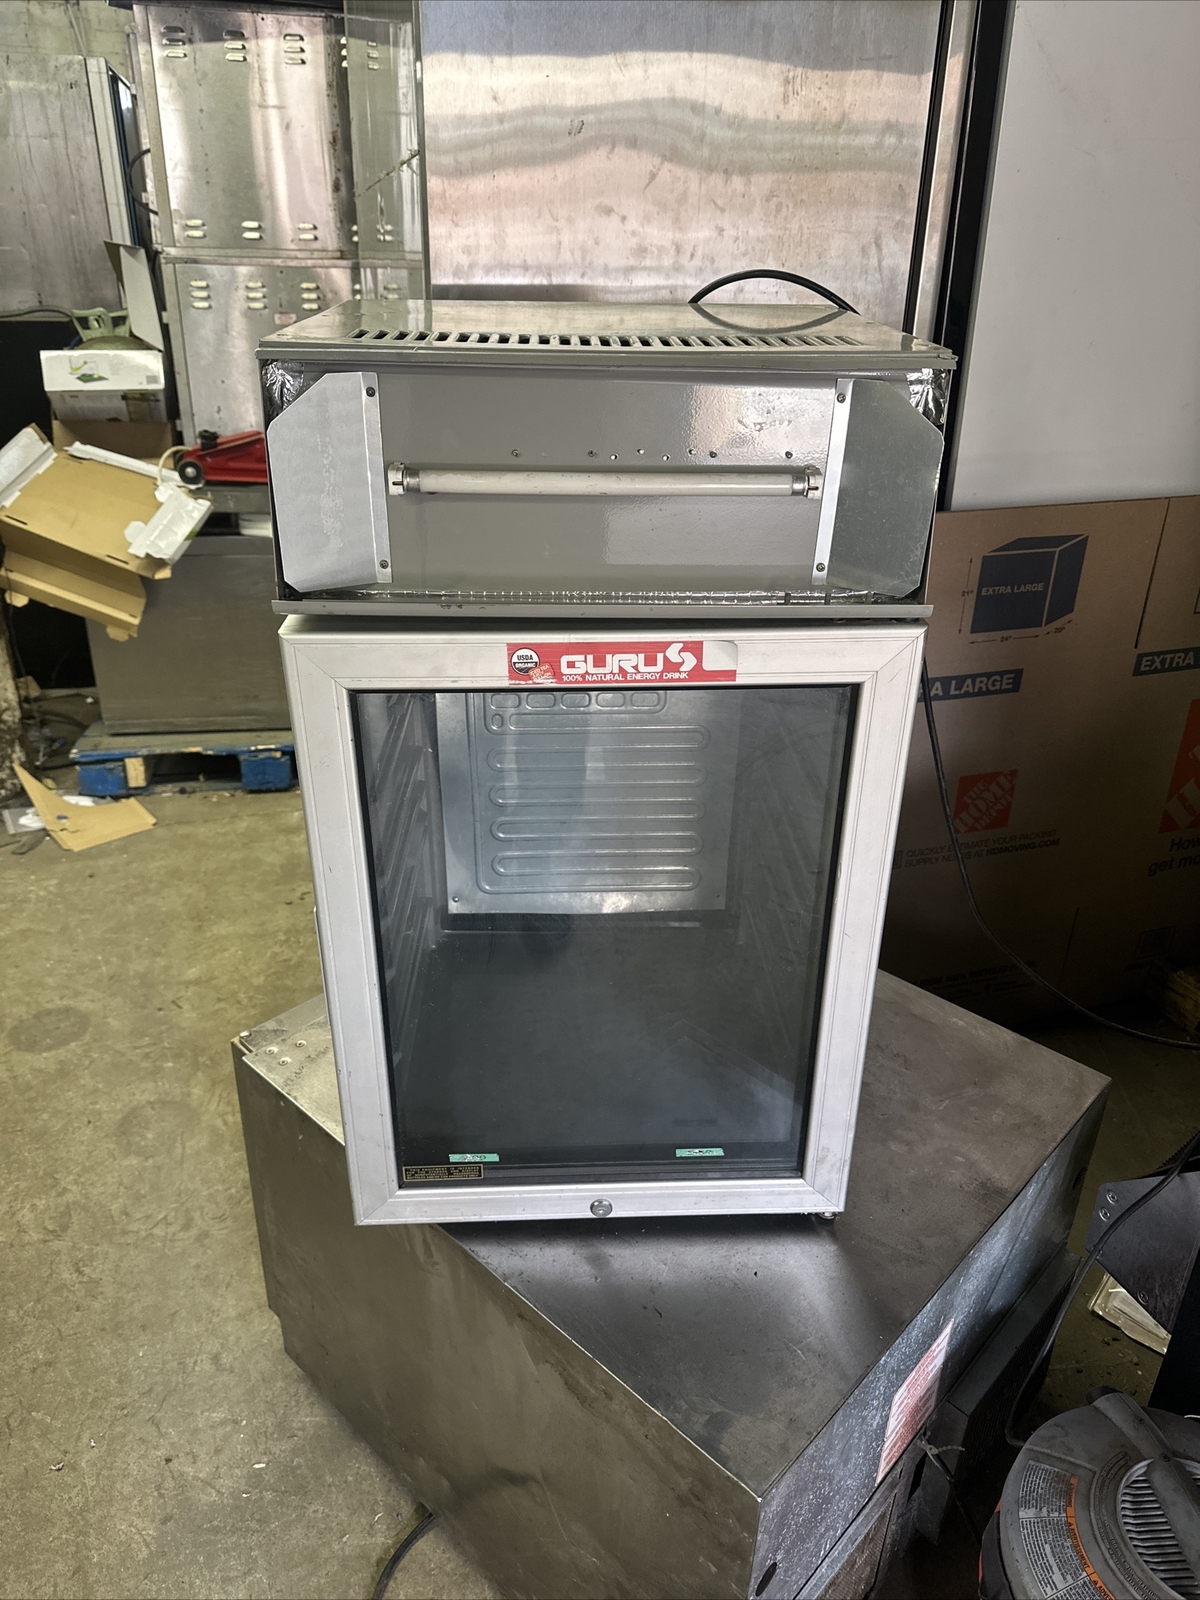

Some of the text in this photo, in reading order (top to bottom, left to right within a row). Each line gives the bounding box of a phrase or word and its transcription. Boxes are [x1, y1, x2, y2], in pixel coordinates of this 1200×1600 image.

[981, 582, 1044, 596] EXTRA LARGE
[516, 654, 534, 662] USDA
[560, 653, 664, 675] GURU
[1140, 651, 1195, 671] EXTRA
[585, 673, 625, 682] NATURAL
[626, 672, 661, 681] ENERGY
[663, 671, 689, 680] DRINK
[949, 673, 1015, 696] LARGE
[954, 771, 1016, 832] HOME
[962, 779, 987, 804] THE
[905, 829, 1058, 858] QUICKLY ETIMATE YOUR PACKING
[904, 855, 940, 869] SUPPLY
[941, 852, 973, 863] NES
[1147, 856, 1175, 877] get
